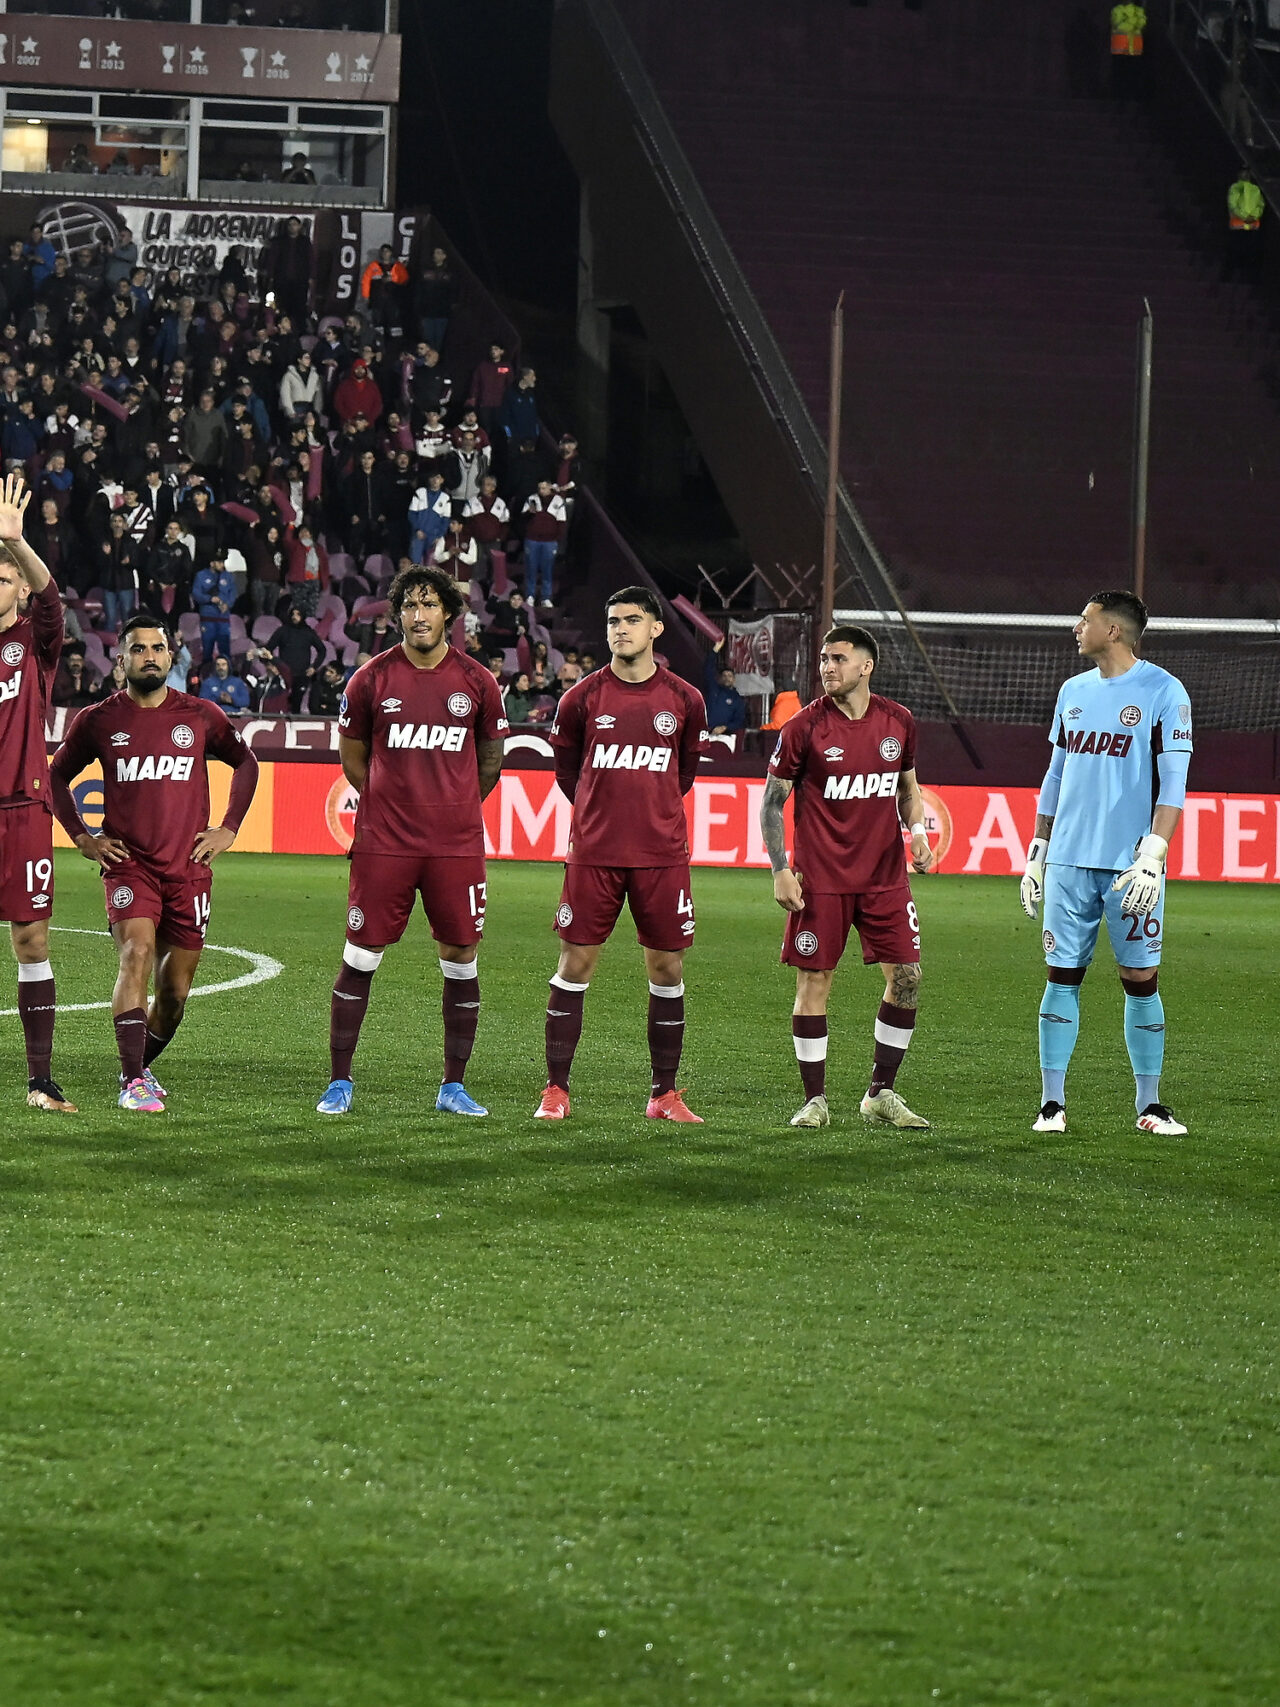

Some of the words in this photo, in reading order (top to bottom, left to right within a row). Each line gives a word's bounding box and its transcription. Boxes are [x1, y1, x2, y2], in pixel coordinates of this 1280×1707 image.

[16, 55, 41, 66] 2007
[143, 211, 171, 239] LA
[337, 214, 357, 299] LOS
[387, 723, 468, 752] MAPEI
[1066, 730, 1134, 758] MAPEI
[116, 755, 195, 782] MAPEI
[591, 743, 673, 773] MAPEI
[823, 771, 900, 801] MAPEI
[26, 858, 52, 893] 19
[193, 892, 211, 927] 14
[468, 882, 488, 917] 13
[677, 889, 694, 918] 4
[906, 901, 920, 933] 8
[1121, 912, 1161, 942] 26
